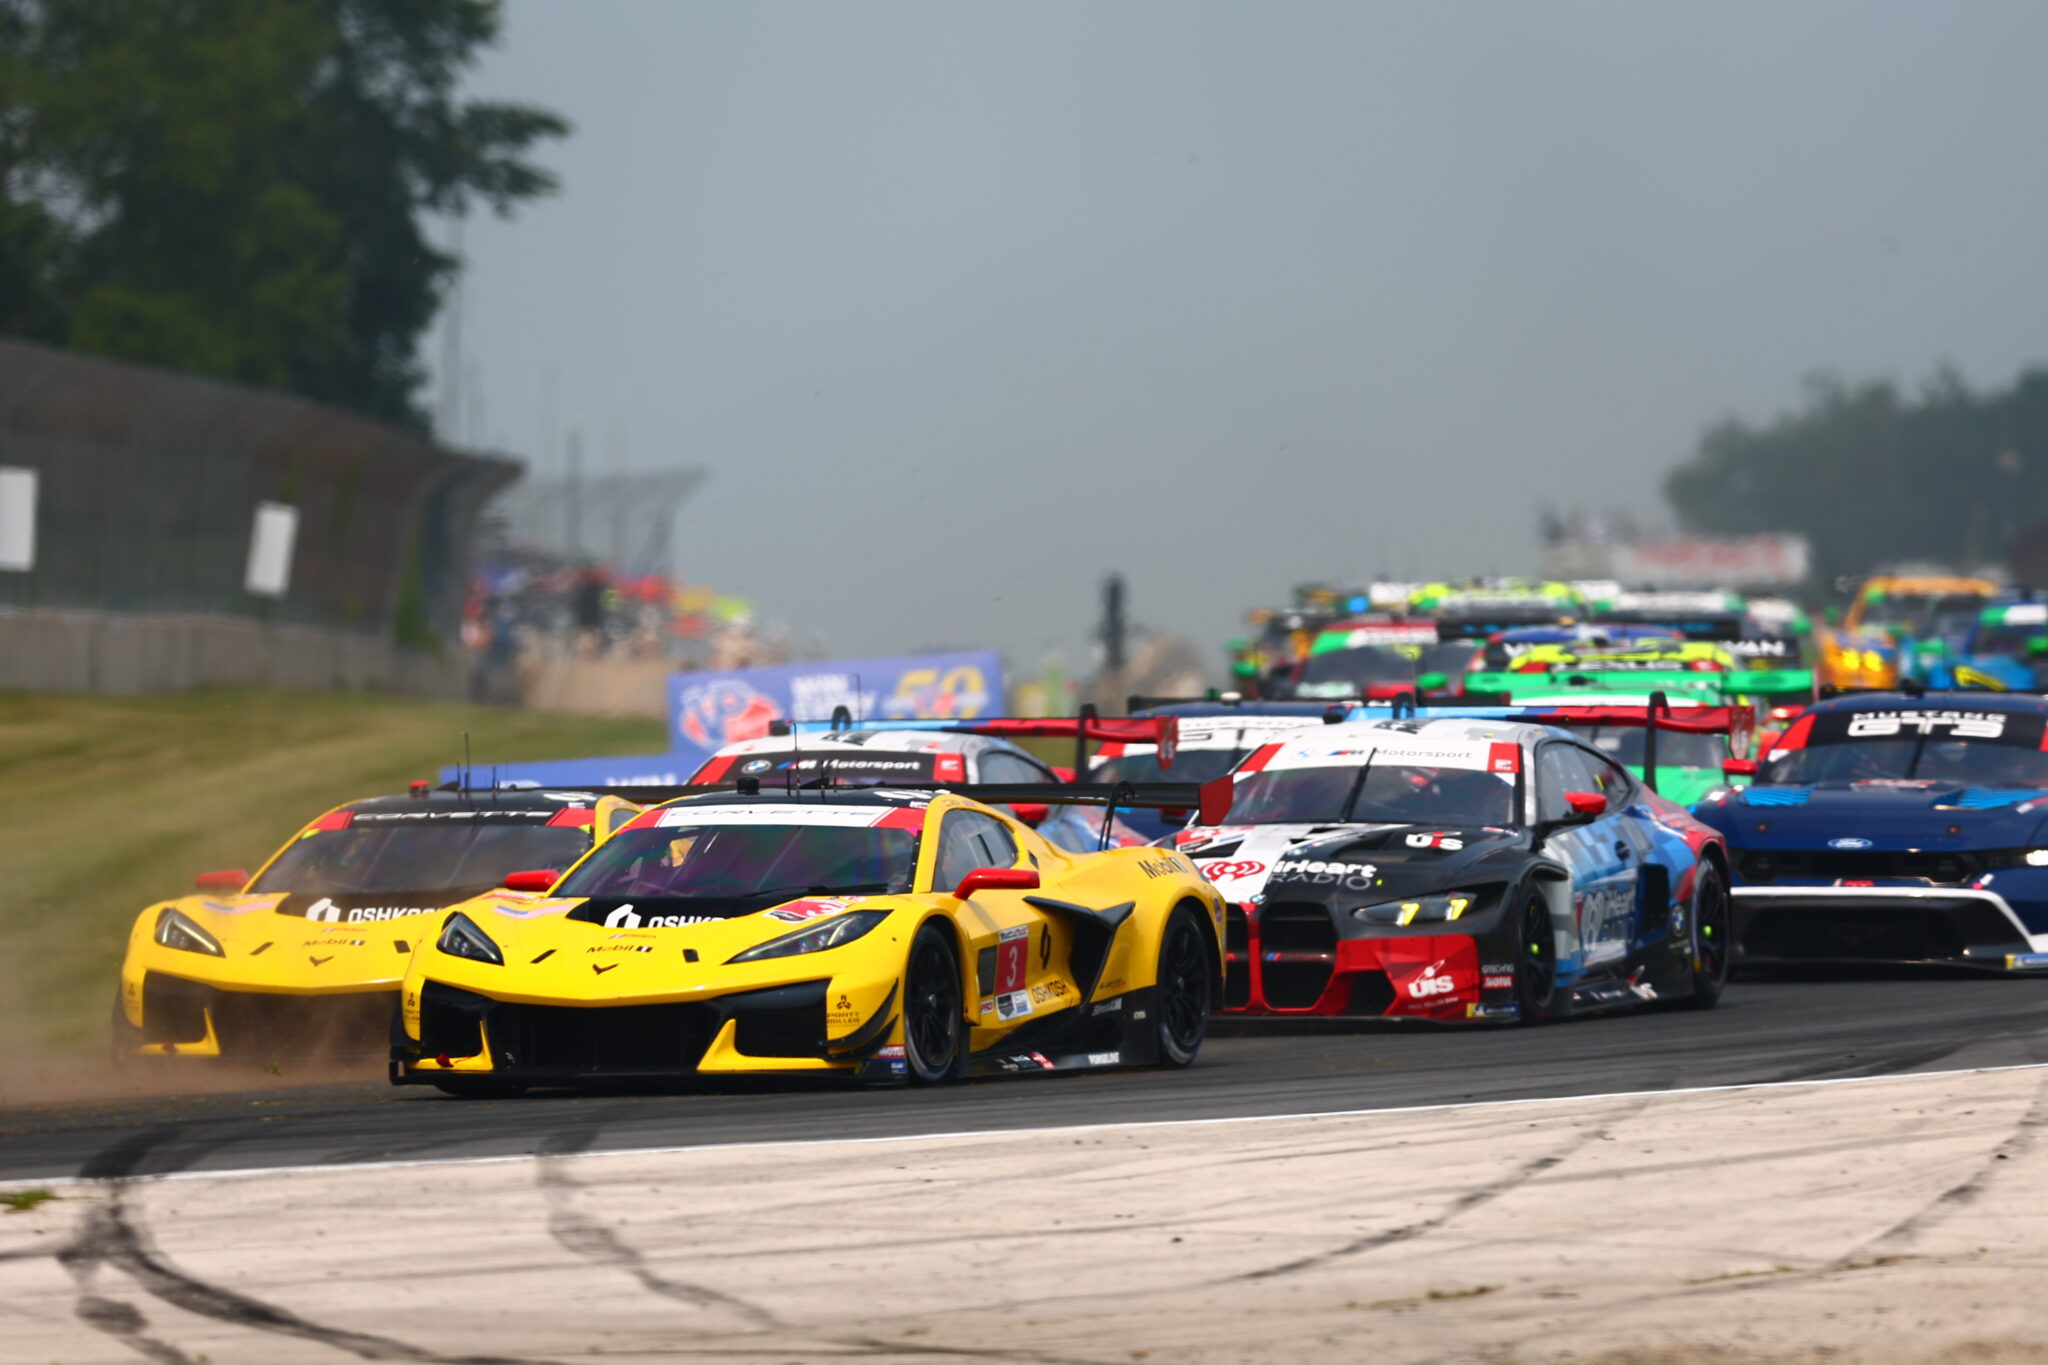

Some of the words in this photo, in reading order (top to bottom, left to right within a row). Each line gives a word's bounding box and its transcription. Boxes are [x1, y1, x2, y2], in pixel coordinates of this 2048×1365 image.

[1852, 710, 2007, 722] MUSTANG
[1847, 718, 2005, 739] GT3
[1376, 748, 1473, 761] Motorsport
[353, 810, 553, 821] CORVETTE
[671, 809, 876, 818] CORVETTE
[1272, 859, 1377, 878] iHeart
[1007, 945, 1018, 989] 3
[1031, 977, 1072, 1004] OSHKOSH
